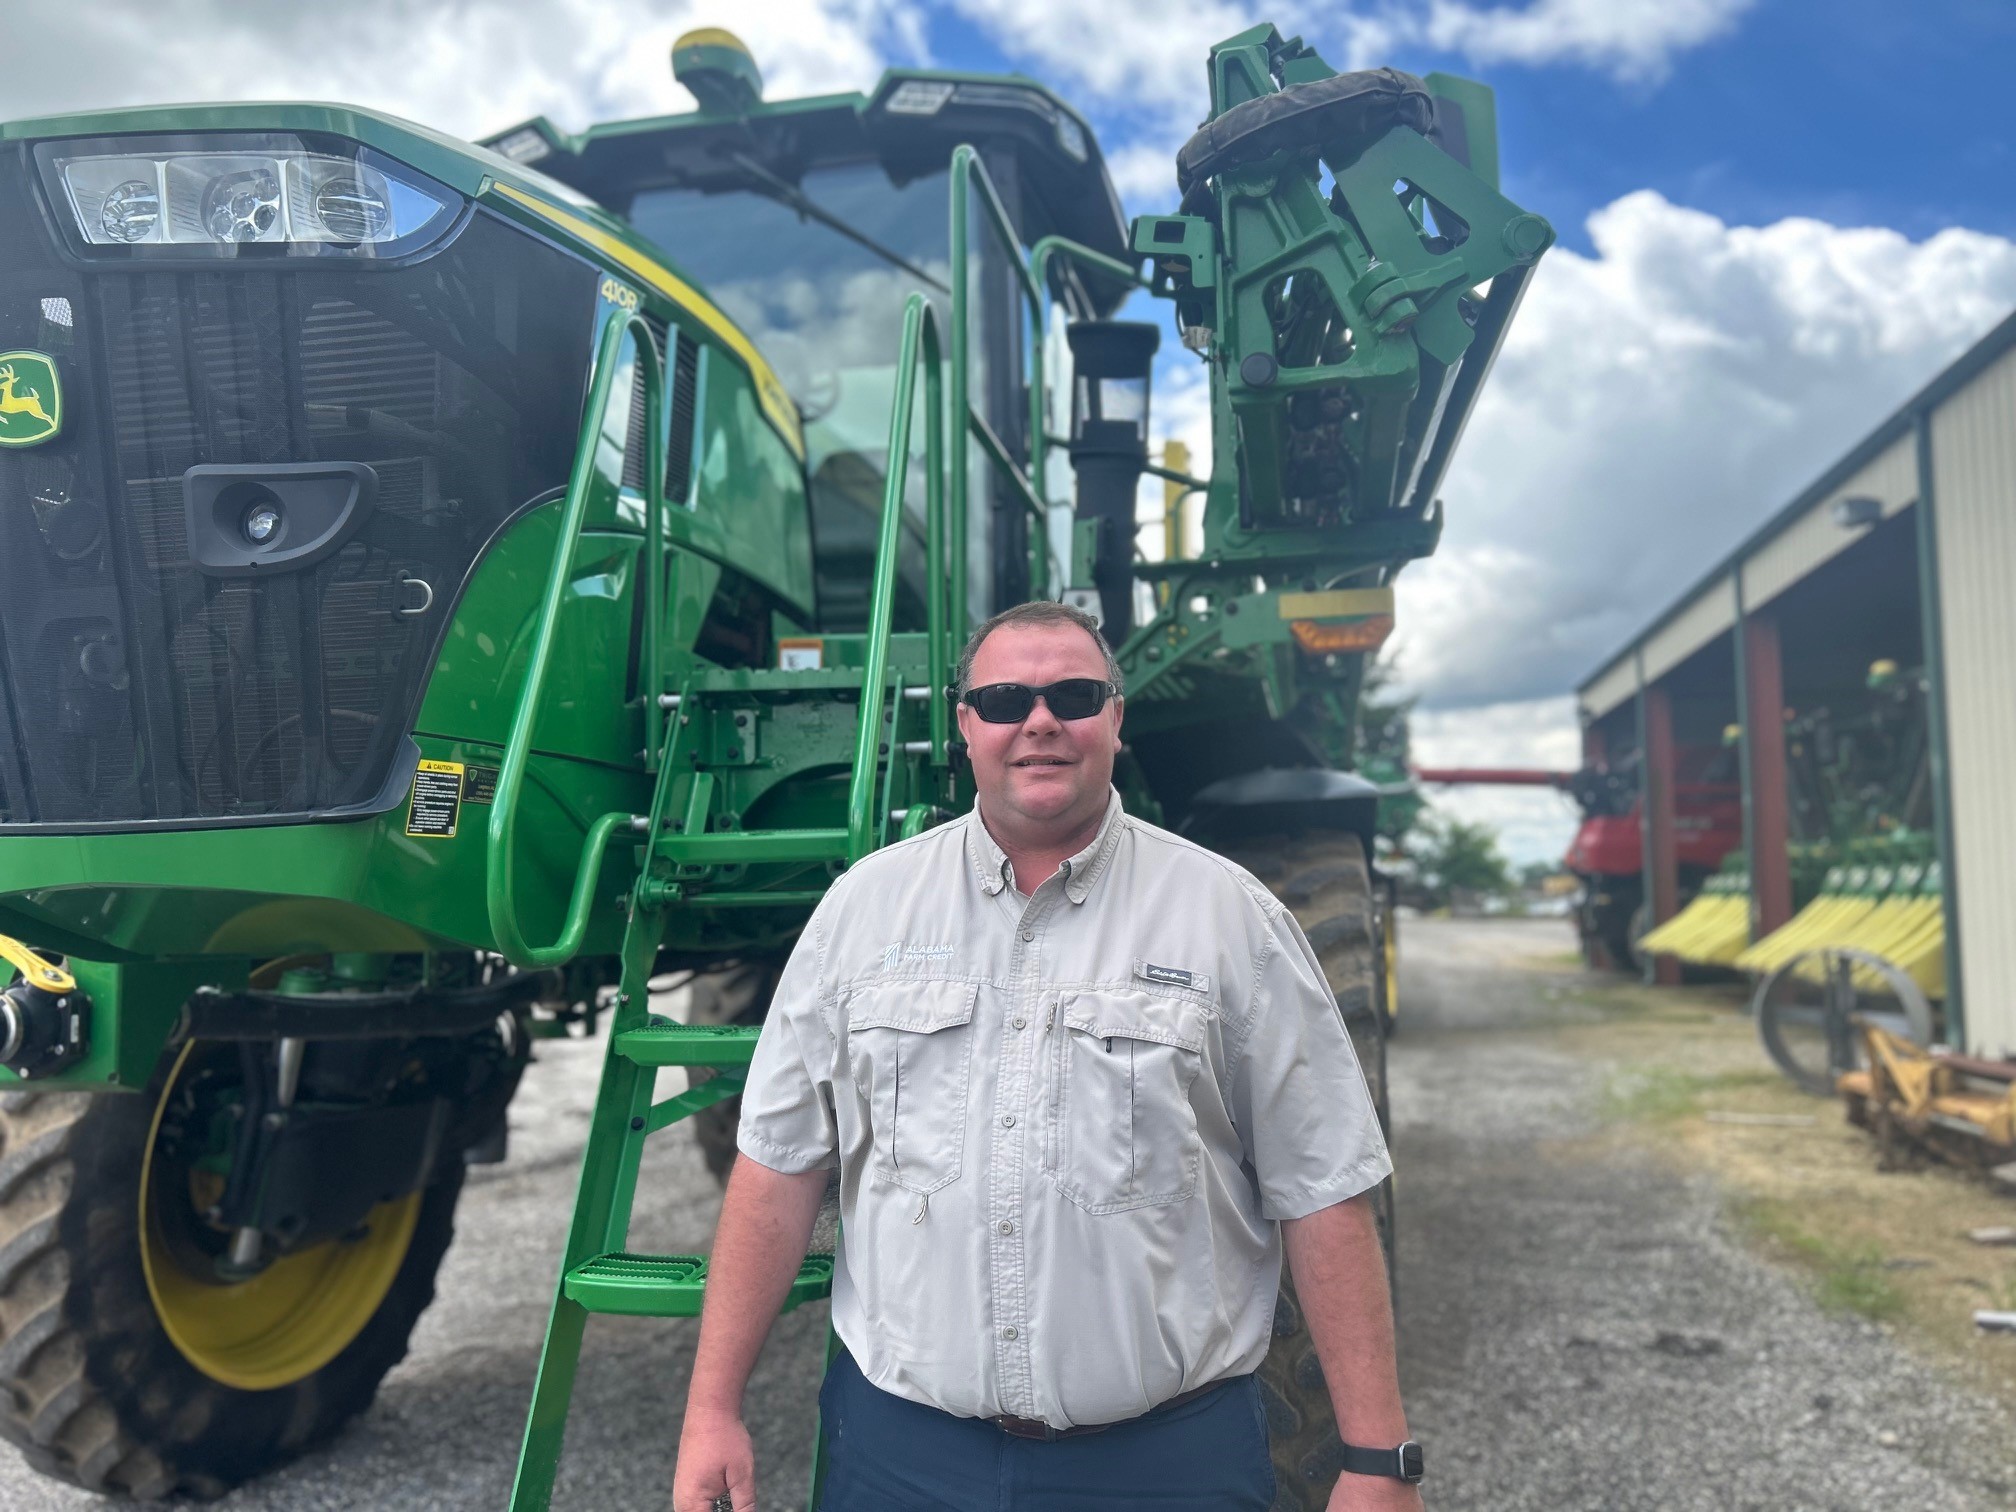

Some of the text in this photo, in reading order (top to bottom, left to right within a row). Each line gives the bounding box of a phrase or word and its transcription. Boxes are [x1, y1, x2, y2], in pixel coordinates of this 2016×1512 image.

[905, 944, 954, 953] ALABAMA
[904, 953, 954, 961] FARM CREDIT
